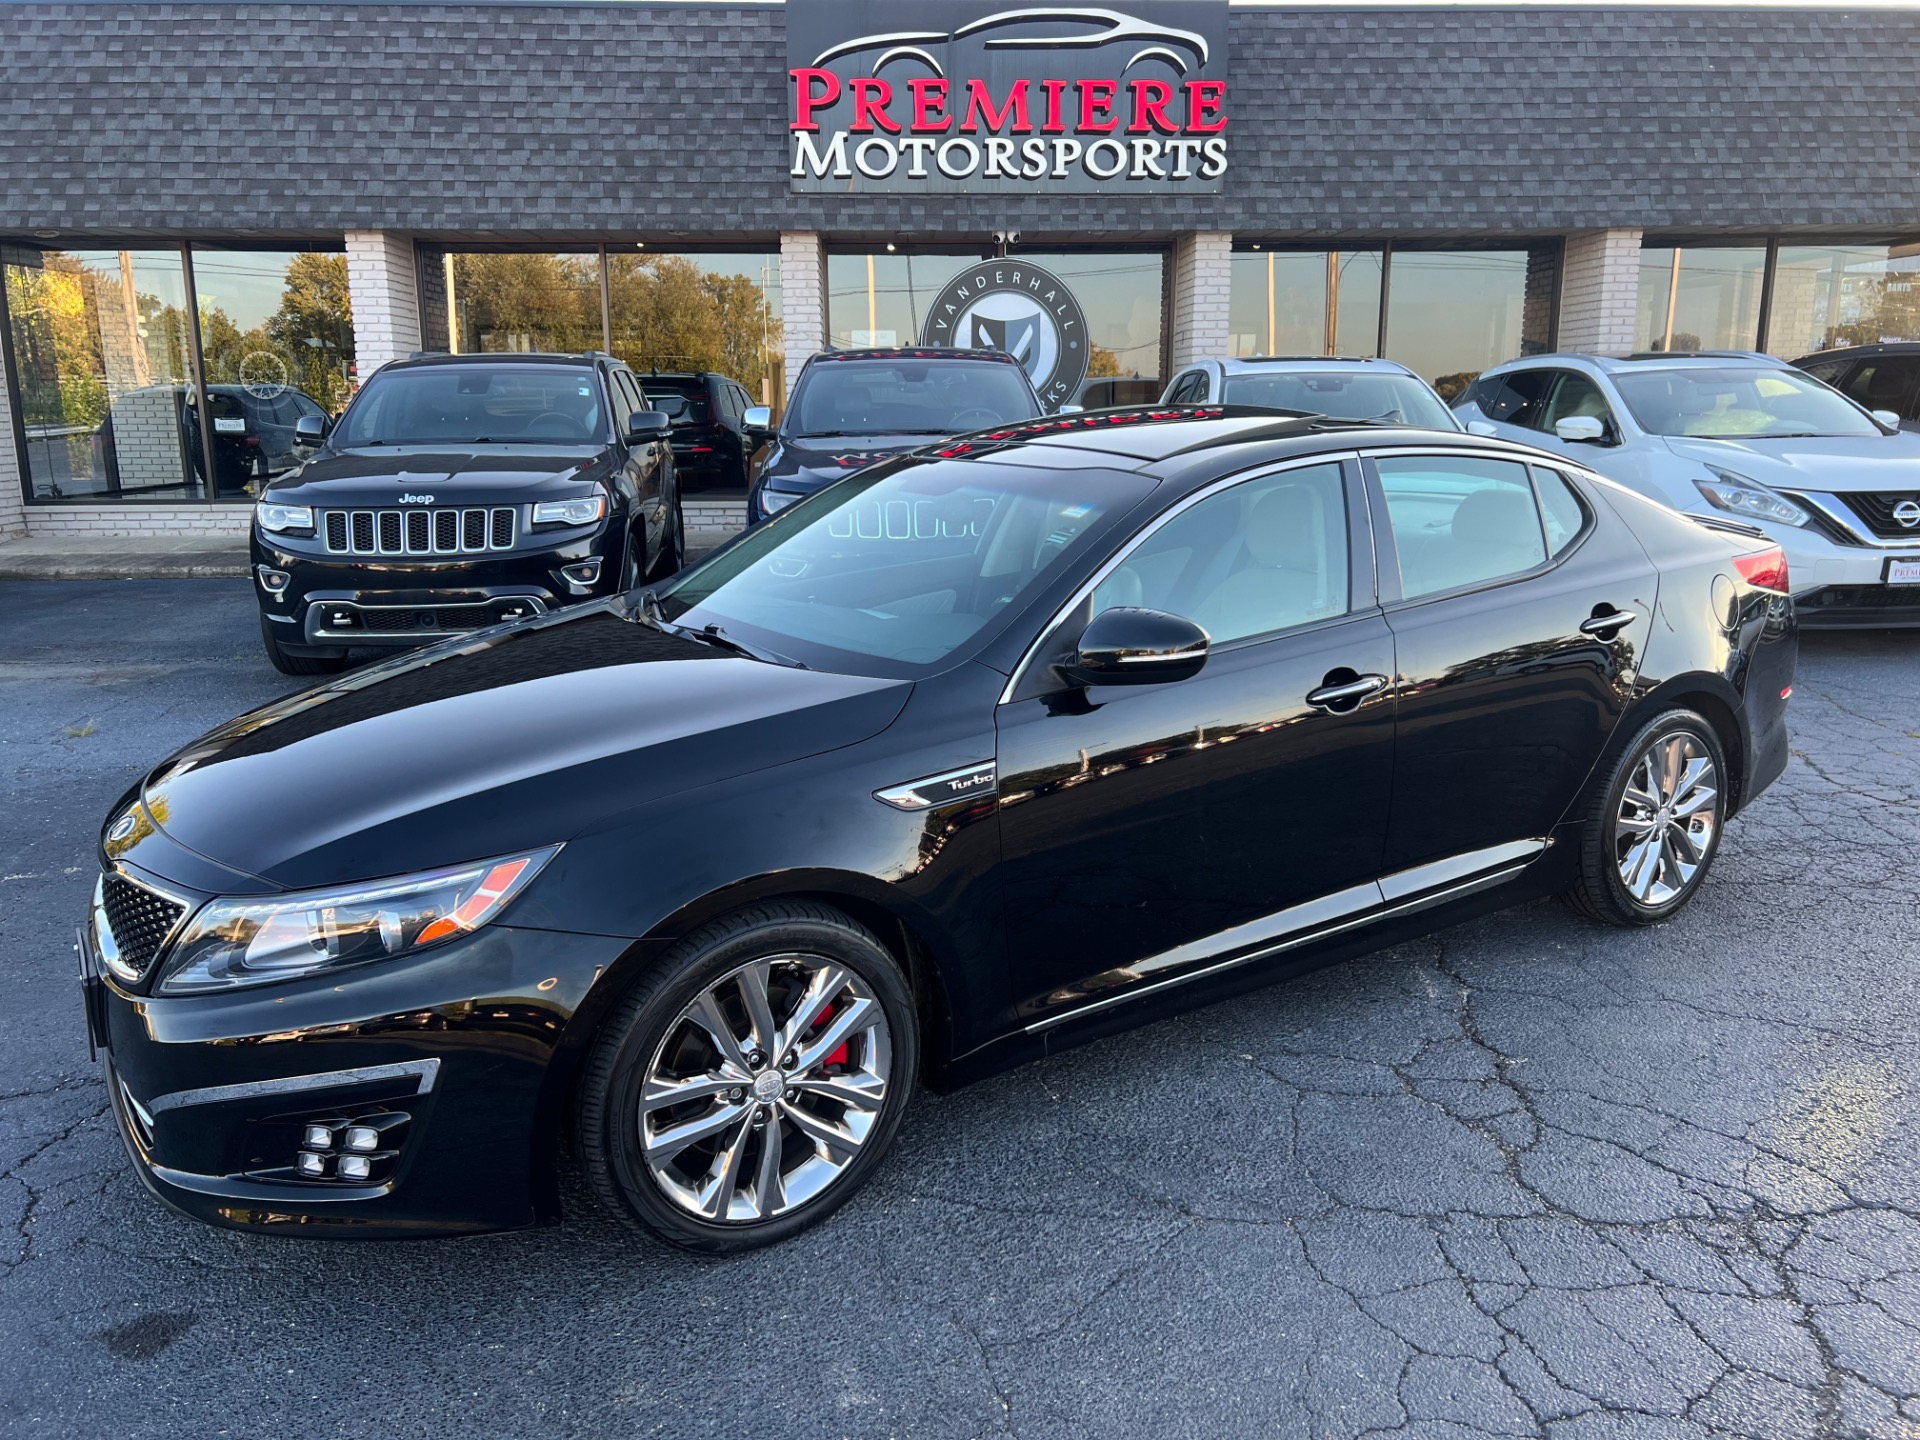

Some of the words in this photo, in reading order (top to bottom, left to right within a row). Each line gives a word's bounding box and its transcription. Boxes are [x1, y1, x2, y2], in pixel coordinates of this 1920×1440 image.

[789, 68, 1229, 133] PREMIERE
[790, 130, 1228, 178] MOTORSPORTS
[935, 271, 1075, 331] VANDERHALL
[398, 493, 435, 505] Jeep
[947, 774, 994, 791] Turbo
